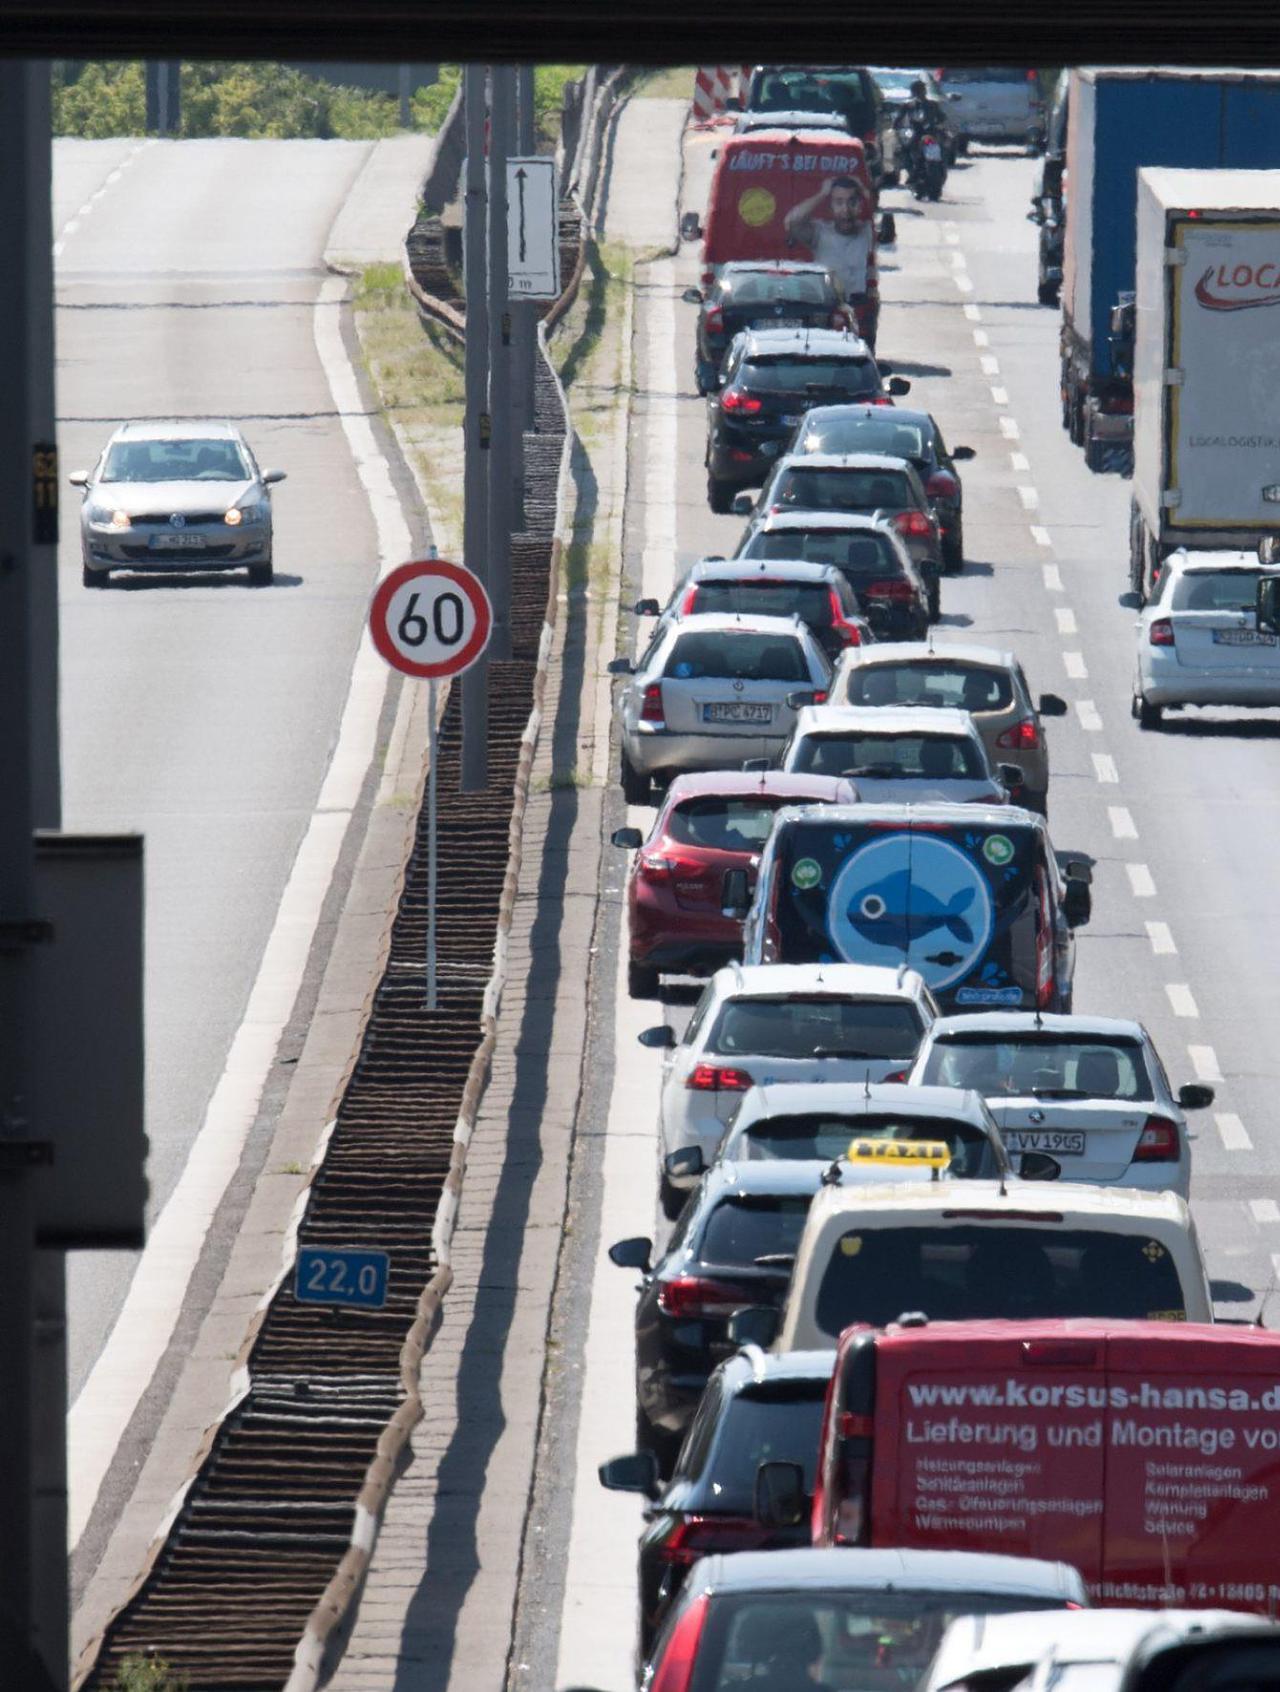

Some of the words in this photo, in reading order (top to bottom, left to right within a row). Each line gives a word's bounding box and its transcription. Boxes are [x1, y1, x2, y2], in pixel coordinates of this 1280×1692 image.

[793, 153, 817, 171] BEI
[820, 155, 859, 172] DIR?
[398, 592, 465, 647] 60
[307, 1258, 377, 1296] 22,0
[906, 1417, 1037, 1451] Lieferung
[1047, 1419, 1102, 1447] und
[1112, 1419, 1236, 1455] Montage
